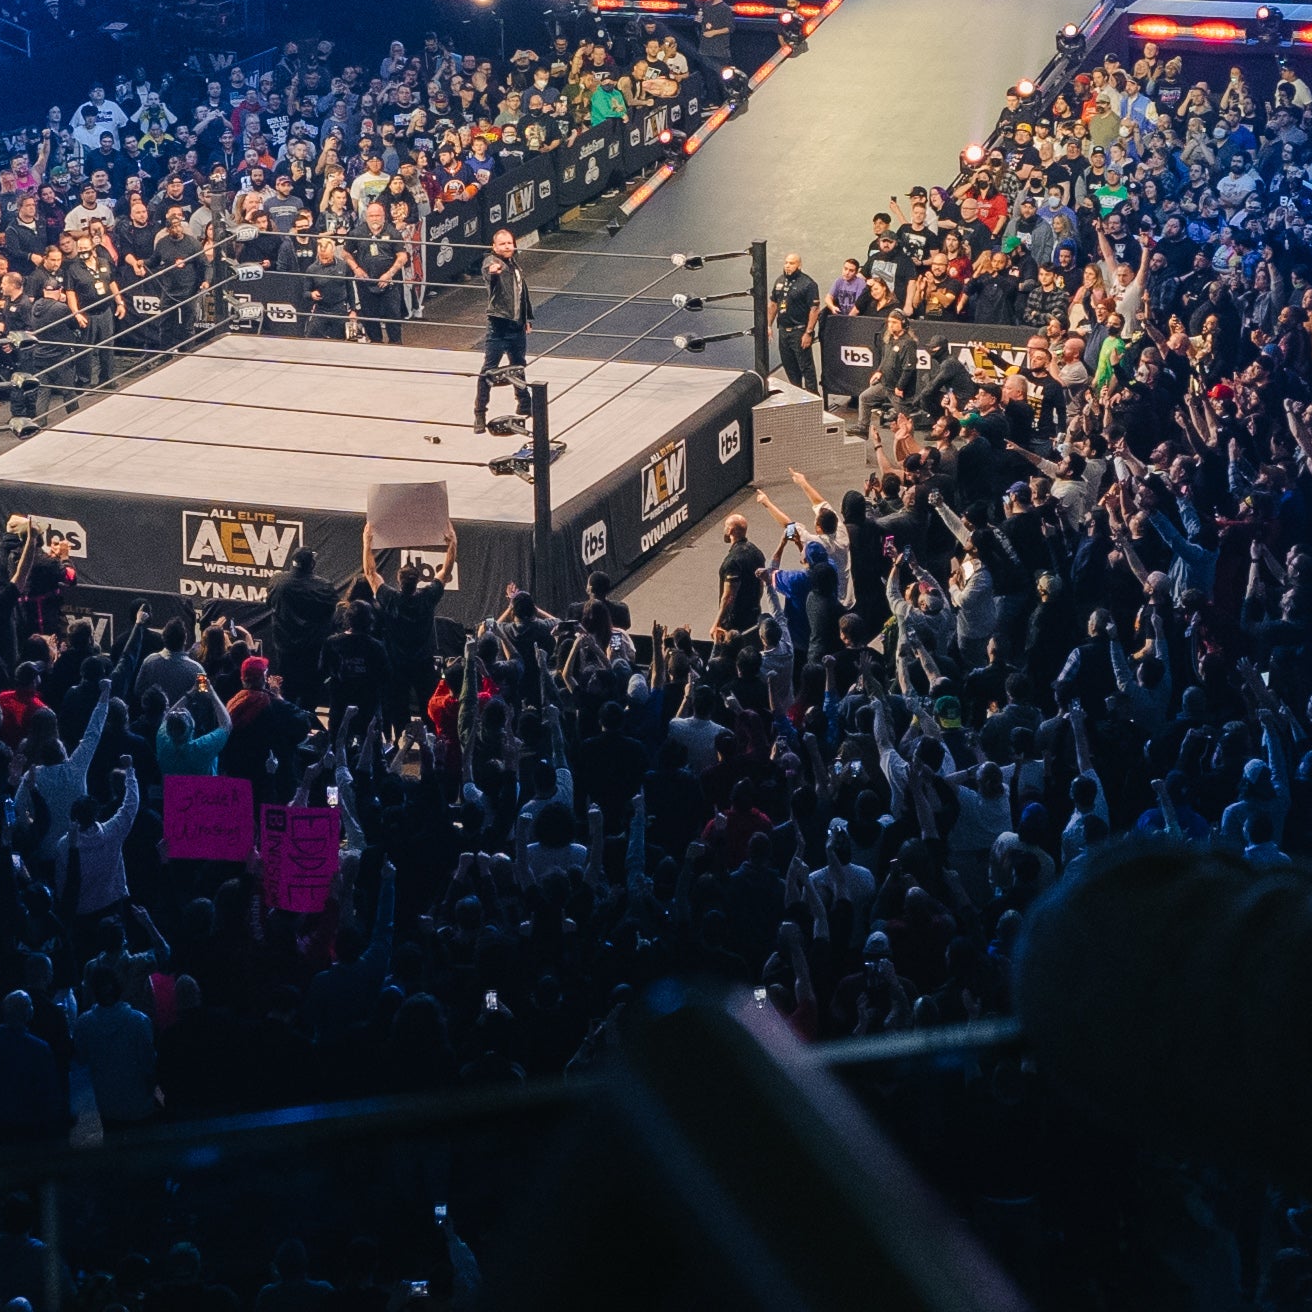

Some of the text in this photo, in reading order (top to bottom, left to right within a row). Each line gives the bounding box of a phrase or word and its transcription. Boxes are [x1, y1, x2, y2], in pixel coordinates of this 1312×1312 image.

[508, 184, 534, 221] AEW
[984, 341, 1012, 350] ELITE
[644, 448, 684, 513] AEW
[210, 508, 276, 523] ALL ELITE
[641, 503, 689, 552] DYNAMITE
[188, 519, 297, 568] AEW
[180, 578, 268, 603] DYNAM
[288, 814, 333, 907] EDDIE
